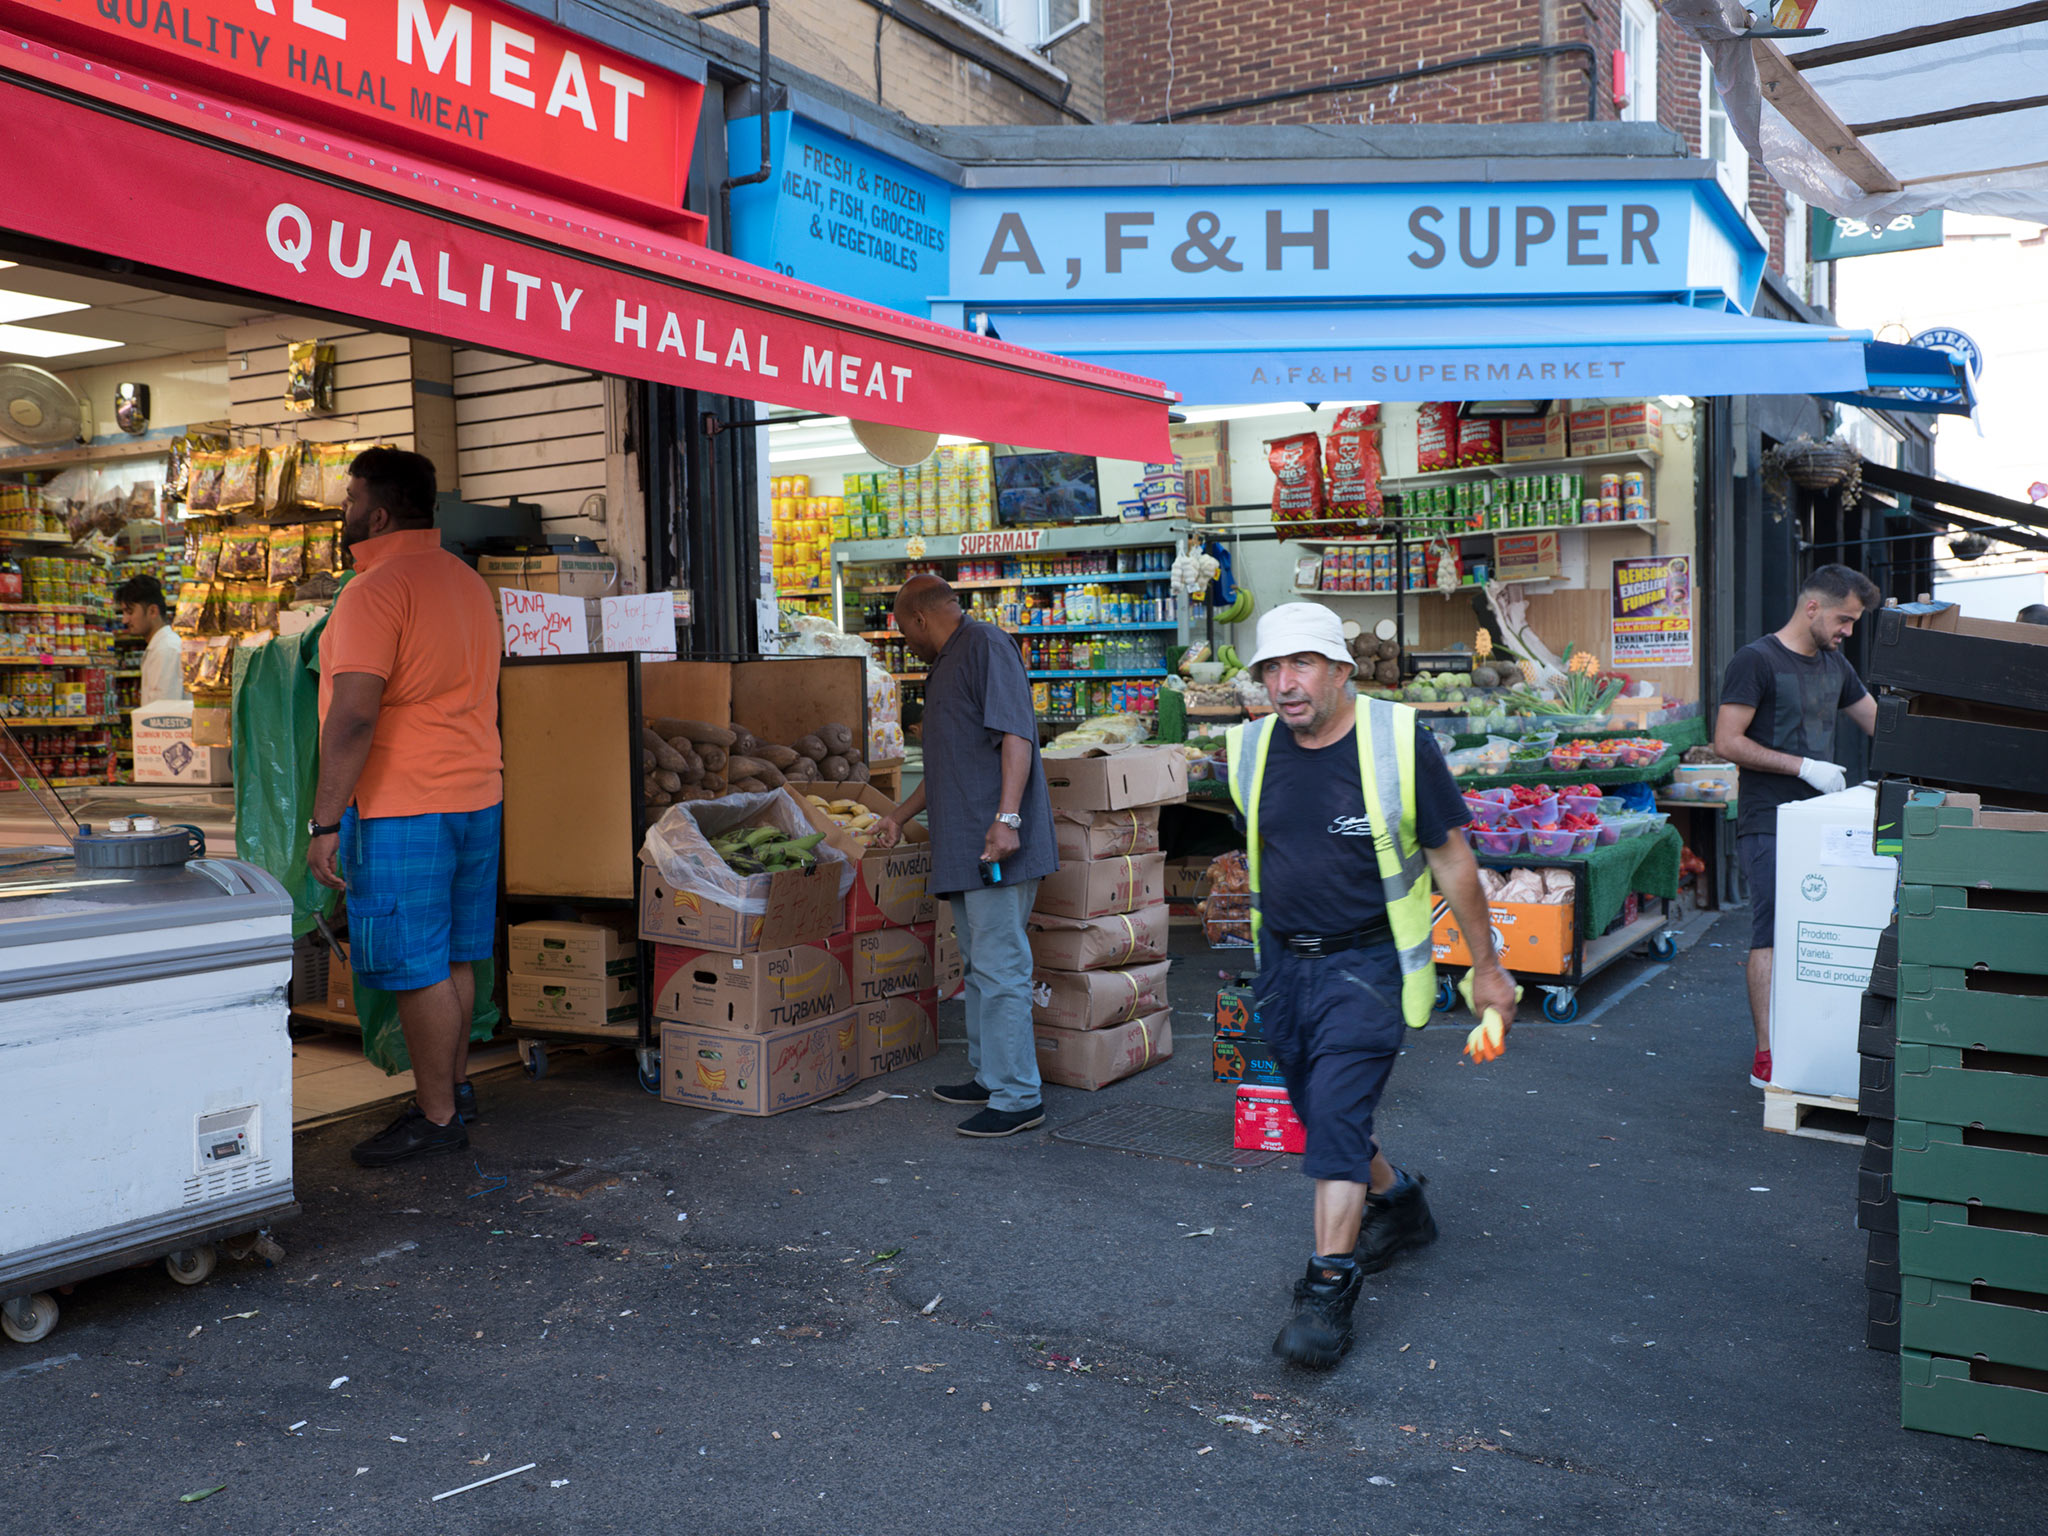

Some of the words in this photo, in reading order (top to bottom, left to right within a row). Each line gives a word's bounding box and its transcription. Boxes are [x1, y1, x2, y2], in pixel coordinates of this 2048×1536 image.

[396, 3, 645, 142] MEAT
[288, 44, 396, 113] HALAL
[410, 87, 489, 142] MEAT
[803, 144, 853, 187] FRESH
[857, 168, 869, 192] &
[874, 174, 926, 215] FROZEN
[829, 187, 869, 229] FISH,
[871, 205, 945, 252] GROCERIES
[809, 214, 823, 240] &
[828, 219, 918, 272] VEGETABLES
[1406, 202, 1661, 270] SUPER
[265, 202, 583, 332] QUALITY
[614, 298, 779, 378] HALAL
[801, 345, 913, 403] MEAT
[1371, 360, 1627, 386] SUPERMARKET
[960, 531, 1040, 555] SUPERMALT
[1618, 566, 1668, 585] BENSONS
[1620, 577, 1667, 599] EXCELLENT
[504, 591, 545, 615] PUNA
[1623, 588, 1667, 613] FUNFAIR
[544, 612, 572, 633] YAM
[606, 600, 620, 631] 2
[624, 598, 641, 617] for
[1662, 619, 1689, 631] £2
[522, 622, 541, 645] for
[1615, 633, 1666, 643] KENNINGTON
[1667, 632, 1689, 641] PARK
[149, 718, 190, 727] MAJESTIC
[860, 937, 879, 952] P50
[1801, 927, 1841, 941] Prodotto:
[1800, 947, 1834, 960] Varietà:
[768, 958, 789, 975] P50
[1800, 966, 1821, 978] Zona
[1823, 969, 1831, 979] di
[861, 972, 920, 999] TURBANA
[770, 994, 836, 1026] TURBANA
[867, 1010, 887, 1026] P50
[870, 1043, 923, 1073] TURBANA
